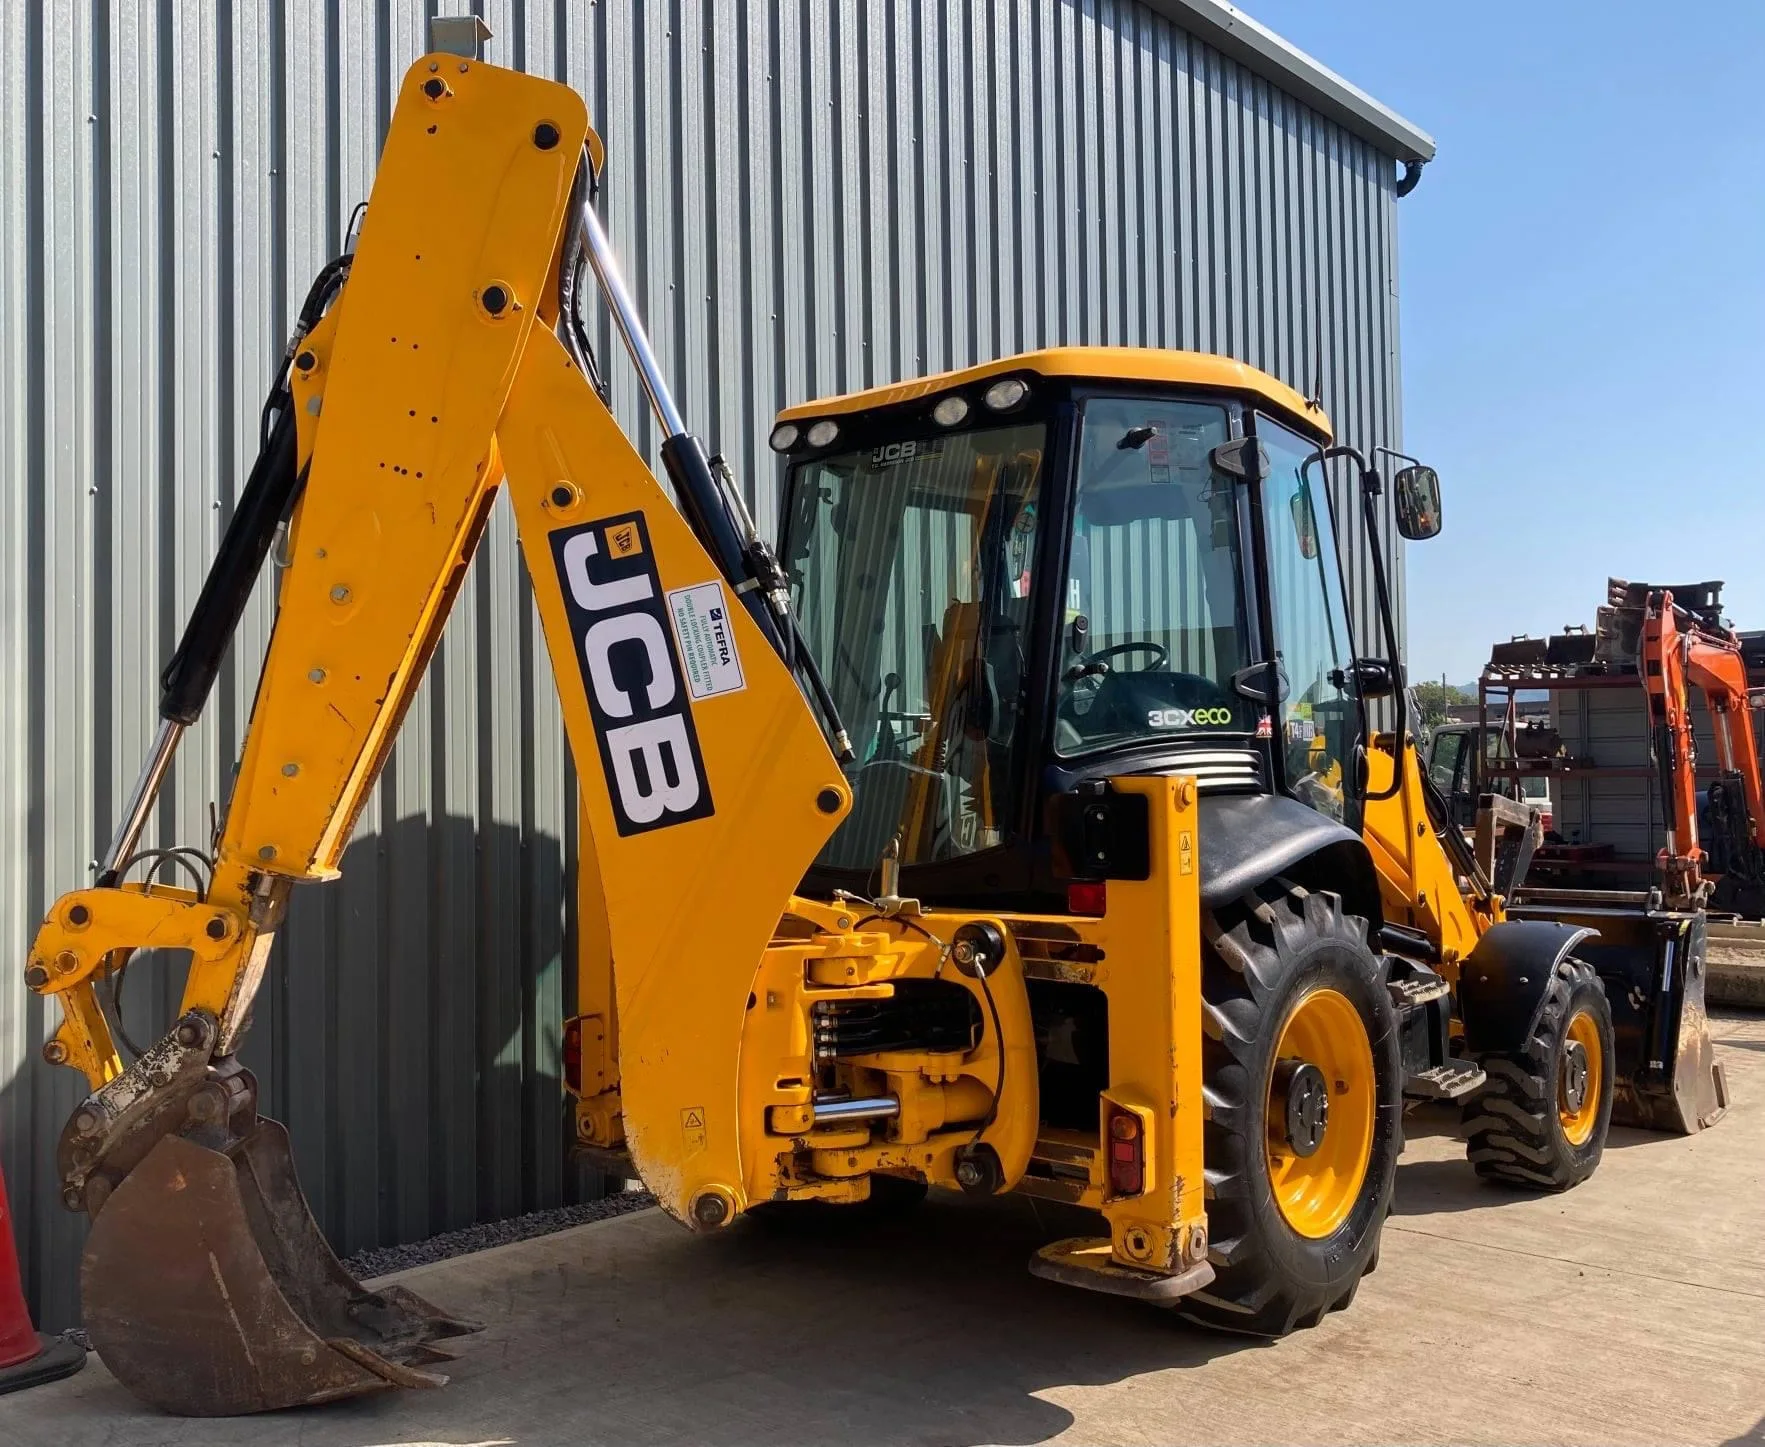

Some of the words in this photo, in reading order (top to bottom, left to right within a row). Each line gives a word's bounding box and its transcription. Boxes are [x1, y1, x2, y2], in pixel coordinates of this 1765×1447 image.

[873, 440, 917, 463] JCB
[615, 531, 631, 552] JCB
[680, 617, 690, 639] SAFETY
[700, 615, 709, 632] FULLY
[684, 594, 696, 618] DOUBLE
[690, 617, 702, 644] LOCKING
[696, 643, 709, 670] COUPLER
[703, 669, 713, 691] FITTED
[685, 638, 693, 652] PIN
[704, 632, 718, 666] AUTOMATIC
[713, 622, 731, 667] TEFRA
[563, 531, 700, 824] JCB
[688, 652, 701, 683] REQUIRED
